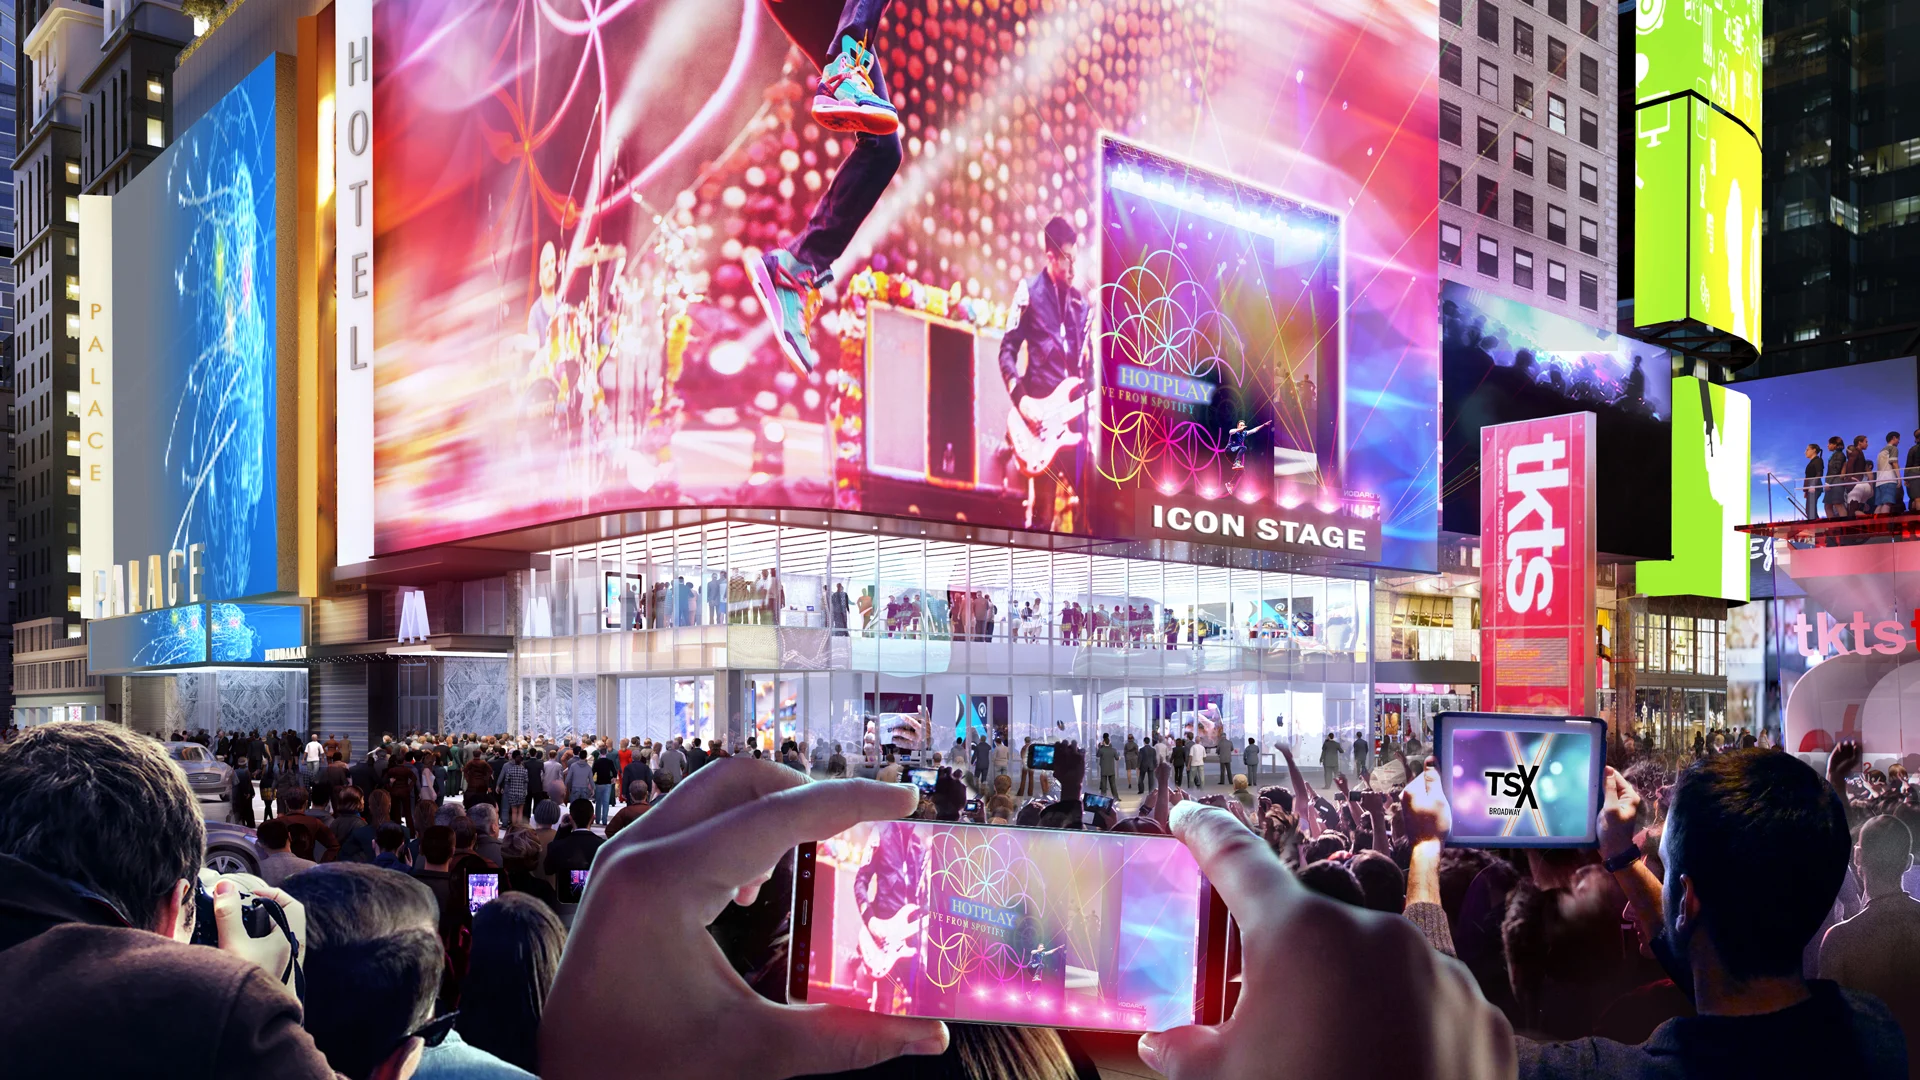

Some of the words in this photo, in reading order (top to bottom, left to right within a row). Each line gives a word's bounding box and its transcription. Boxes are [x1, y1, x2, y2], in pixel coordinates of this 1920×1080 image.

[347, 36, 369, 372] HOTEL
[87, 303, 104, 482] PALACE
[1118, 389, 1148, 405] FROM
[1151, 396, 1195, 415] SPOTIFY
[1121, 367, 1213, 402] HOTPLAY
[1152, 504, 1245, 537] ICON
[1256, 518, 1367, 551] STAGE
[1506, 432, 1569, 614] tkts
[93, 543, 205, 619] PALACE
[1793, 611, 1907, 656] tkts
[1485, 765, 1540, 809] TSX
[1488, 807, 1521, 816] BROADWAY
[946, 915, 969, 929] FROM
[971, 921, 1006, 938] SPOTIFY
[952, 899, 1015, 927] HOTPLAY
